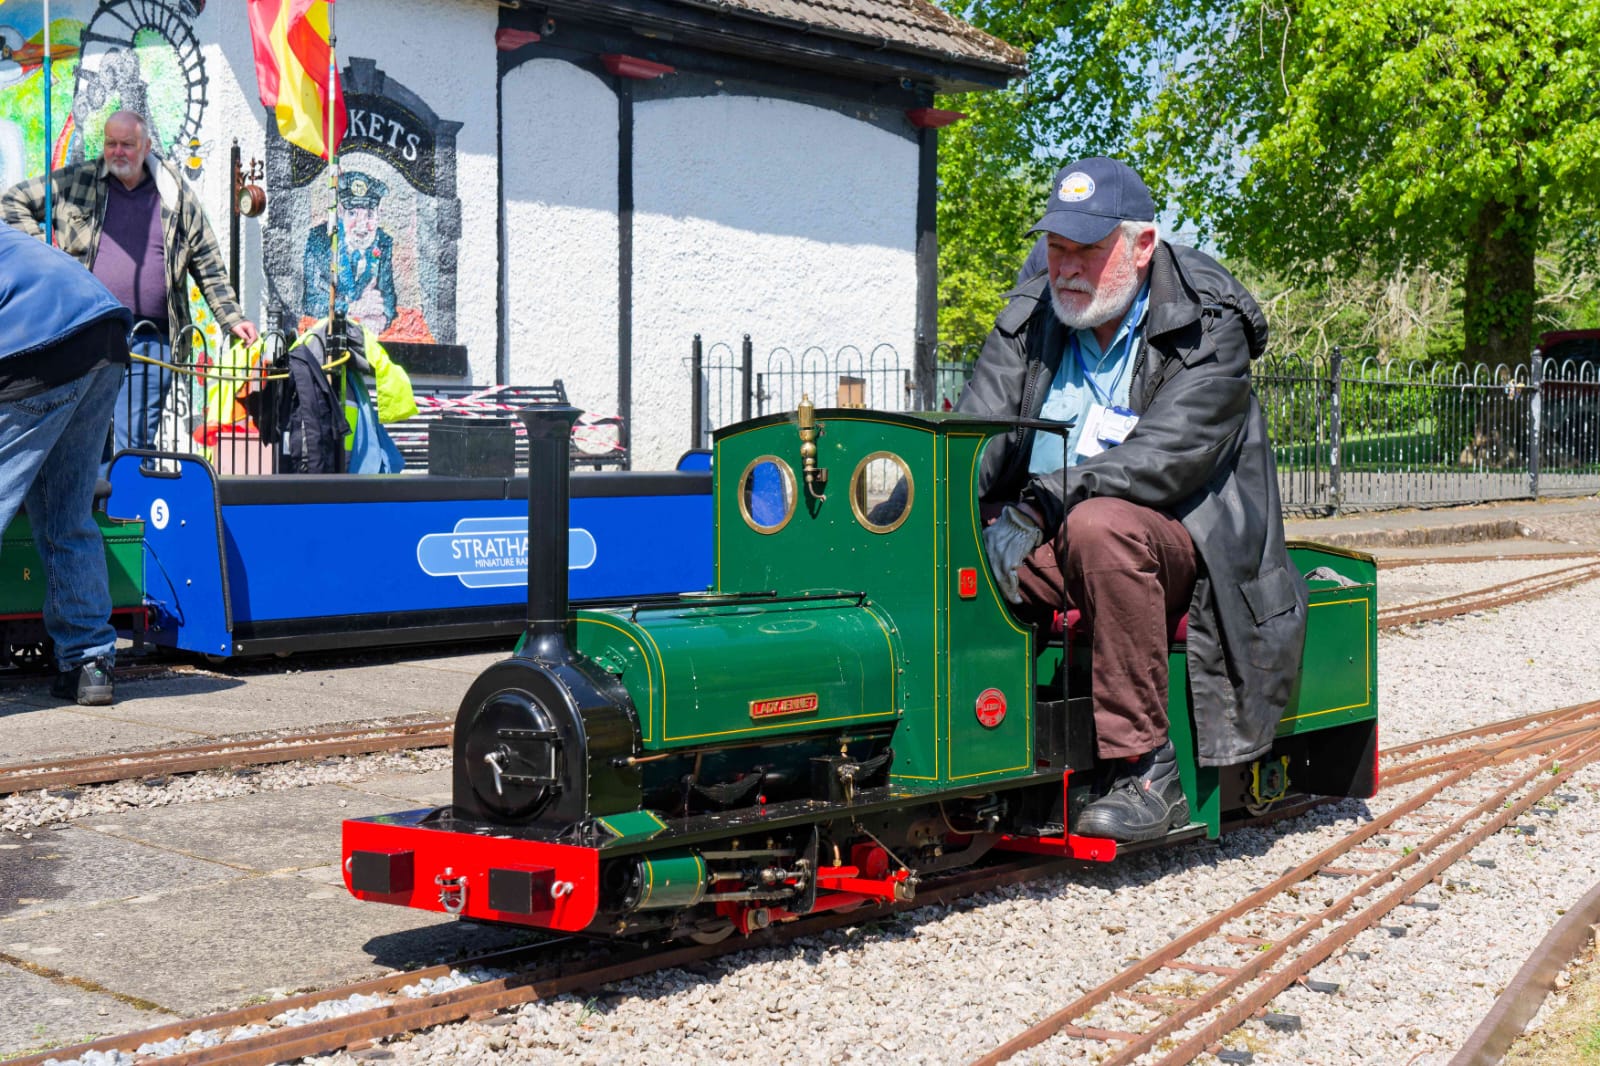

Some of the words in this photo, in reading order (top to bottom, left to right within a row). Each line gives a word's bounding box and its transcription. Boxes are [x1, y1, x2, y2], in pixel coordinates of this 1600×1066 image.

[344, 108, 421, 162] KETS
[156, 506, 164, 521] 5
[451, 536, 529, 559] STRATHA
[475, 558, 515, 568] MINIATURE
[23, 567, 31, 581] R
[963, 575, 974, 588] 19
[754, 702, 779, 715] LADY
